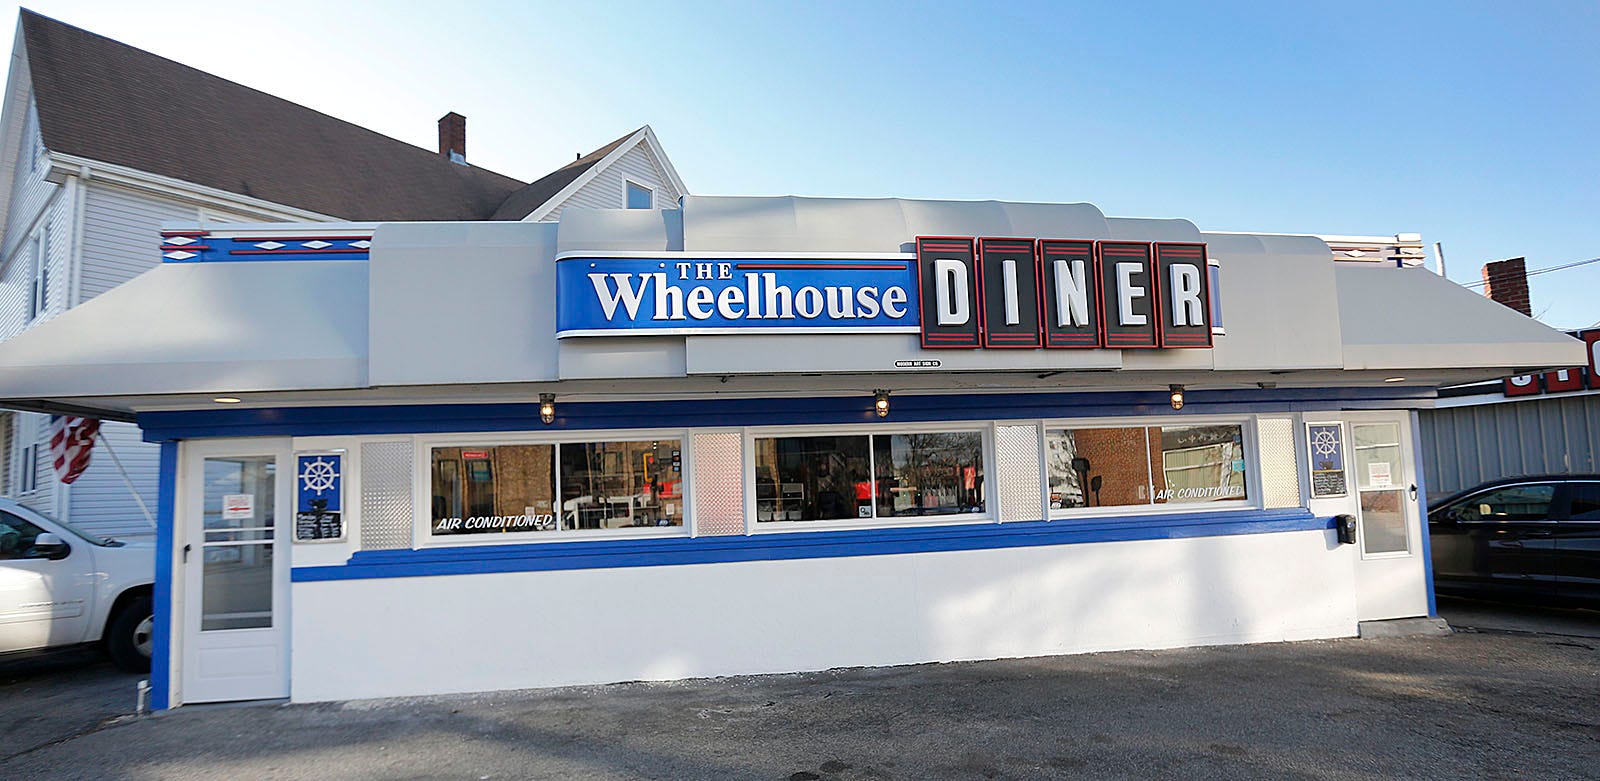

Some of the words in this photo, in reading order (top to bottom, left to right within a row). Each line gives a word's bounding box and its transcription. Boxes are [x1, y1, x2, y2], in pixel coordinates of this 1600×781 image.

[676, 262, 732, 279] THE
[588, 272, 907, 321] Wheelhouse
[935, 259, 1203, 328] DINER
[1155, 489, 1174, 499] AIR
[1178, 486, 1242, 498] CONDITIONED
[436, 518, 462, 530] AIR
[465, 515, 552, 529] CONDITIONED
